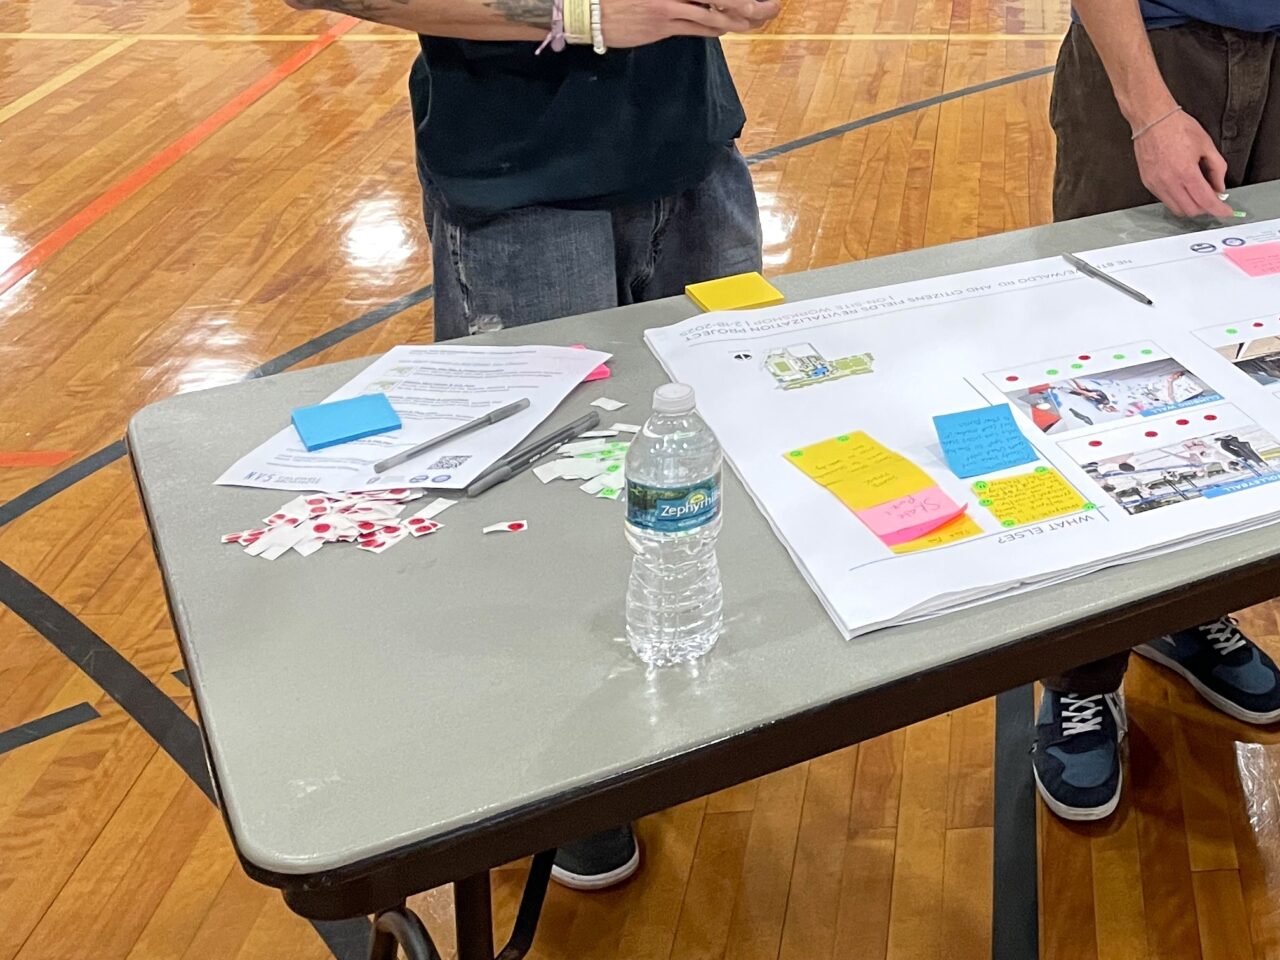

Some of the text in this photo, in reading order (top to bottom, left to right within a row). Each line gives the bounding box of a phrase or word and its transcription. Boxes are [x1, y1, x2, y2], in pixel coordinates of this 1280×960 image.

[1018, 268, 1080, 284] VE/WALDO
[908, 288, 964, 303] CITIZENS
[966, 284, 992, 294] AND
[860, 300, 905, 312] FIELDS
[750, 308, 858, 333] REVITALIZATION
[754, 307, 833, 325] WORKSHOP
[685, 327, 747, 341] PROJECT
[998, 514, 1096, 544] WHAT ELSE?
